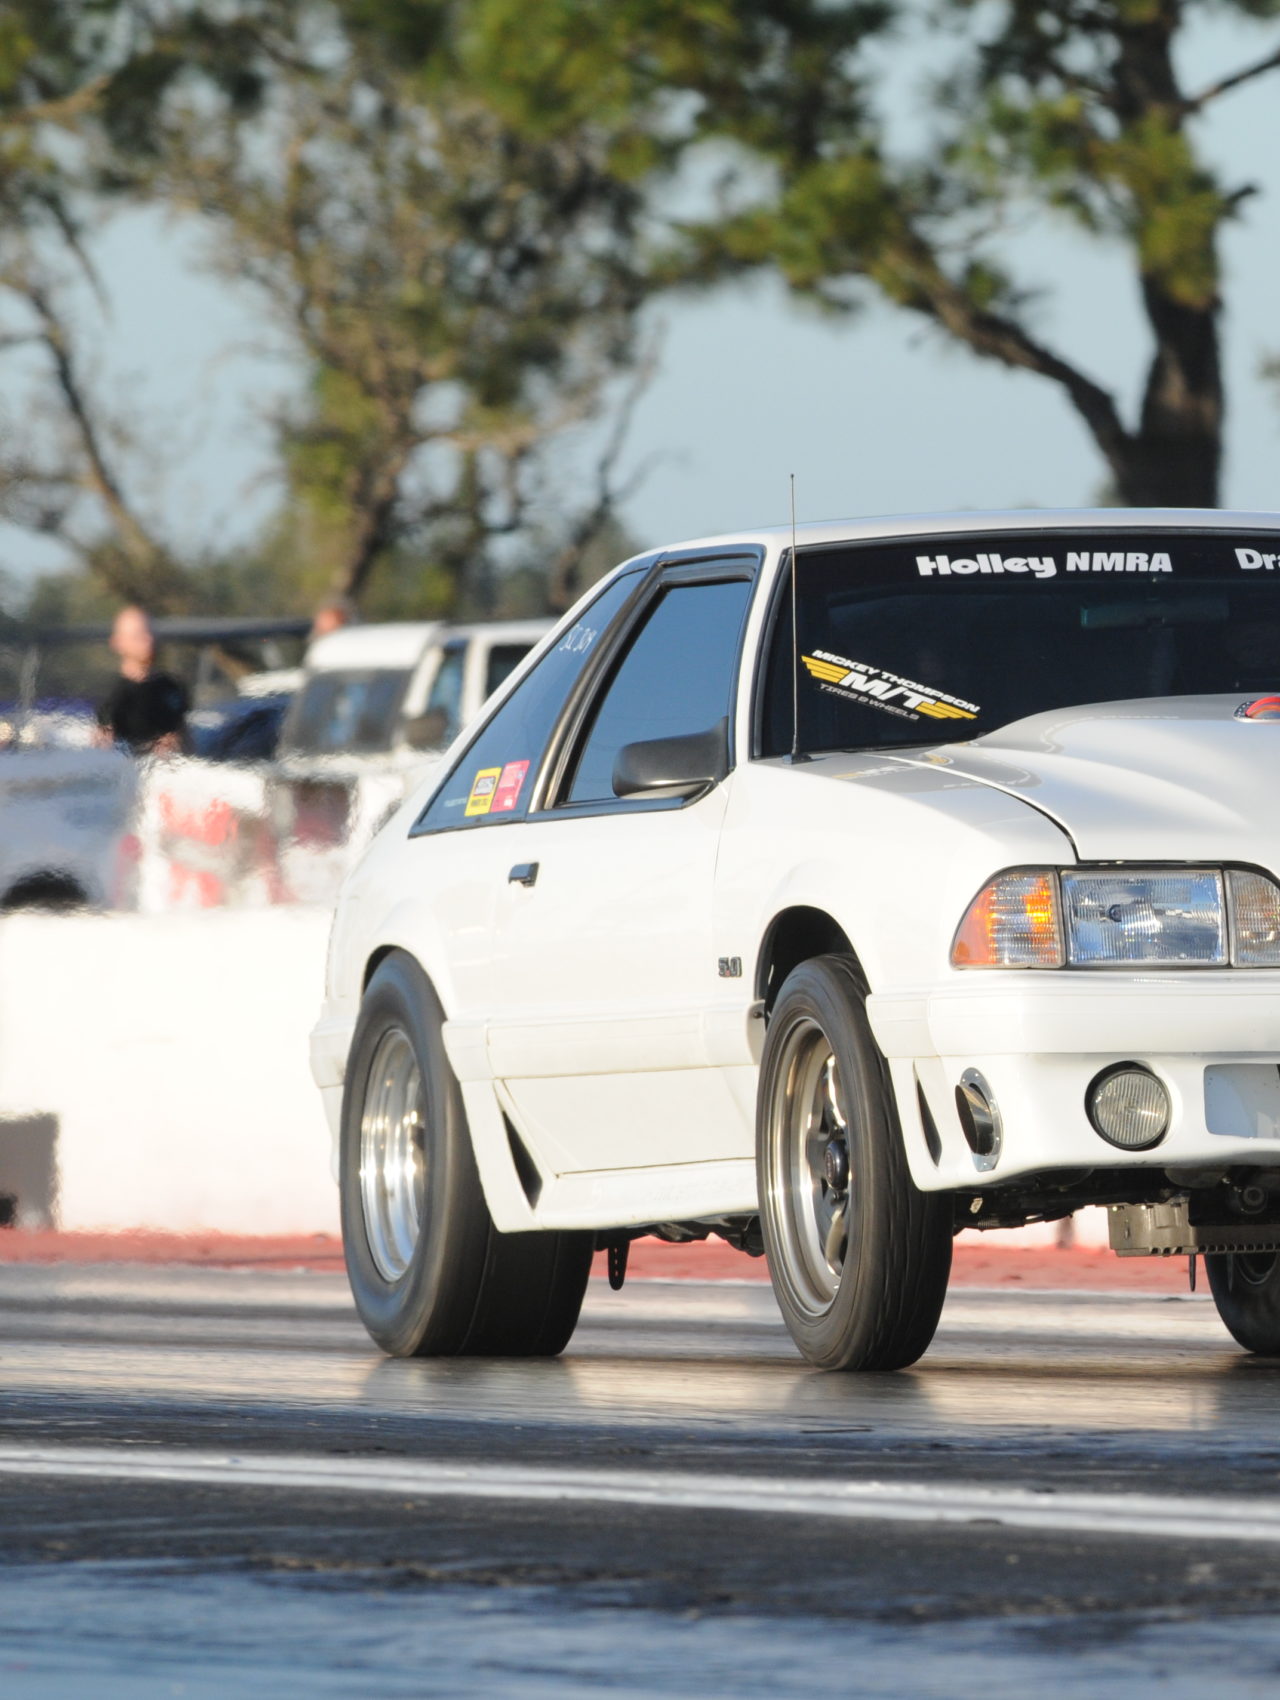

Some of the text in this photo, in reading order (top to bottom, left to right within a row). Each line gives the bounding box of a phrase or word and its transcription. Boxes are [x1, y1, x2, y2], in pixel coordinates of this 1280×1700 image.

[916, 553, 1057, 579] Holley
[1065, 551, 1173, 573] NMRA
[811, 649, 982, 713] MICKEY THOMPSON
[819, 683, 856, 702] TIRES
[868, 699, 920, 721] WHEELS
[718, 957, 742, 977] 5.0
